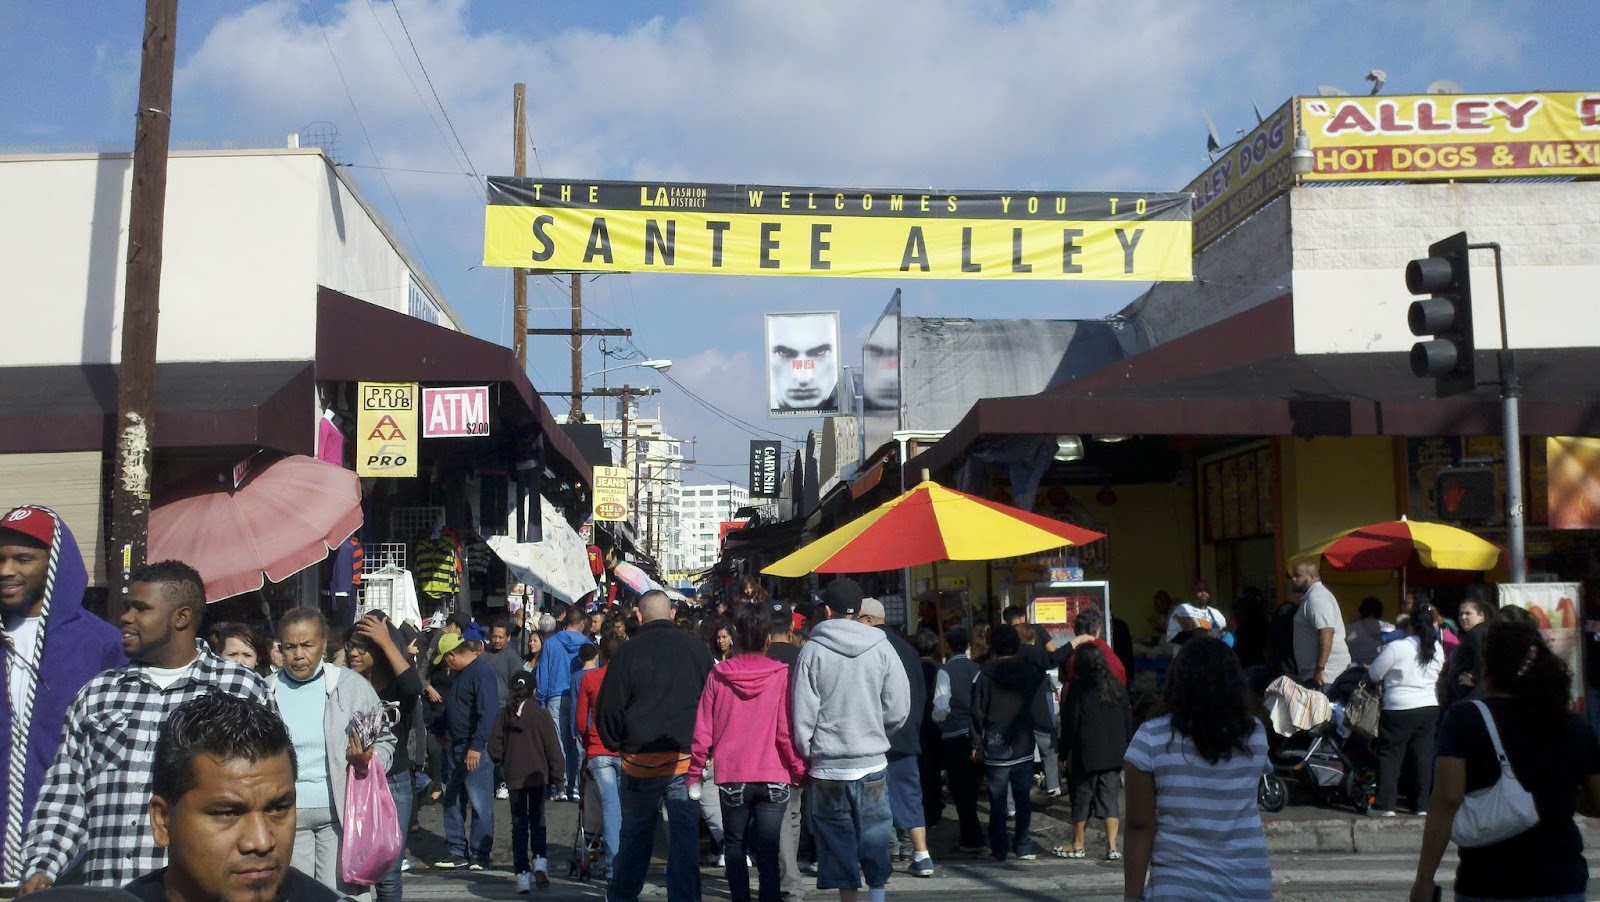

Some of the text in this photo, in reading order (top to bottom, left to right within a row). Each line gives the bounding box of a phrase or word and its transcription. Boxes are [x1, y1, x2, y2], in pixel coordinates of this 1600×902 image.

[1316, 148, 1379, 171] HOT
[1391, 145, 1478, 170] DOGS
[1491, 144, 1515, 167] &
[670, 187, 707, 198] FASHION
[533, 184, 1147, 215] THE LA WELCOMES YOU TO
[670, 197, 706, 208] DISTRICT
[531, 214, 832, 270] SANTEE
[899, 225, 1145, 274] ALLEY
[371, 388, 405, 400] PRO
[366, 397, 410, 408] CLUB
[428, 393, 484, 432] ATM
[466, 422, 489, 435] $2.00
[367, 456, 407, 467] PRO
[597, 478, 625, 487] JEANS
